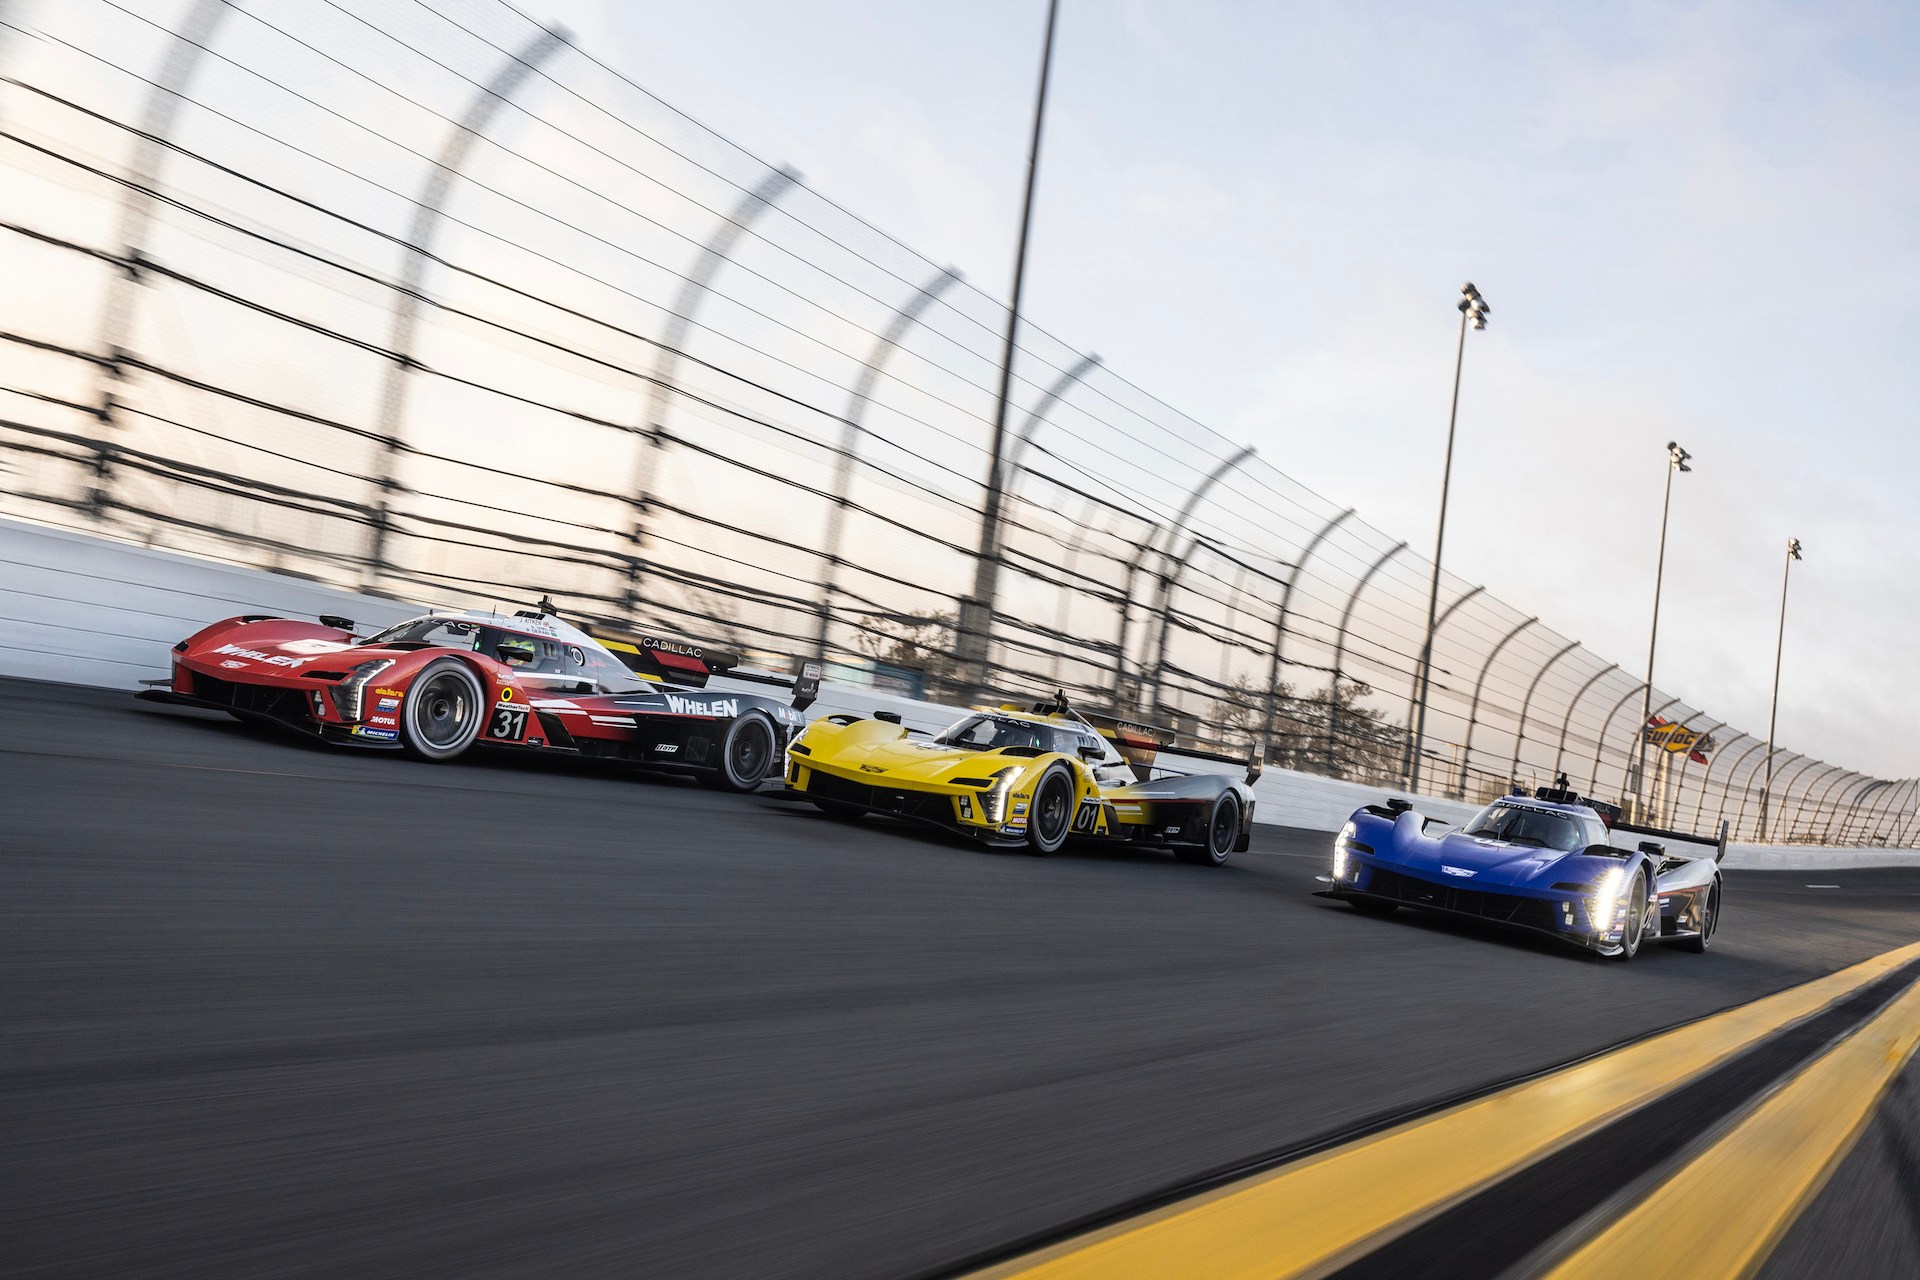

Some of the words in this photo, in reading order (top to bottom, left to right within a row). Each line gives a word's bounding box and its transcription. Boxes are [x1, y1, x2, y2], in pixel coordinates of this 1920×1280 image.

[643, 637, 702, 658] CADILLAC
[664, 694, 738, 718] WHELEN
[370, 715, 396, 726] MOTUL
[493, 710, 525, 740] 31
[1117, 721, 1153, 737] CADILLAC
[366, 730, 396, 738] MICHELIN
[1077, 805, 1098, 830] 01
